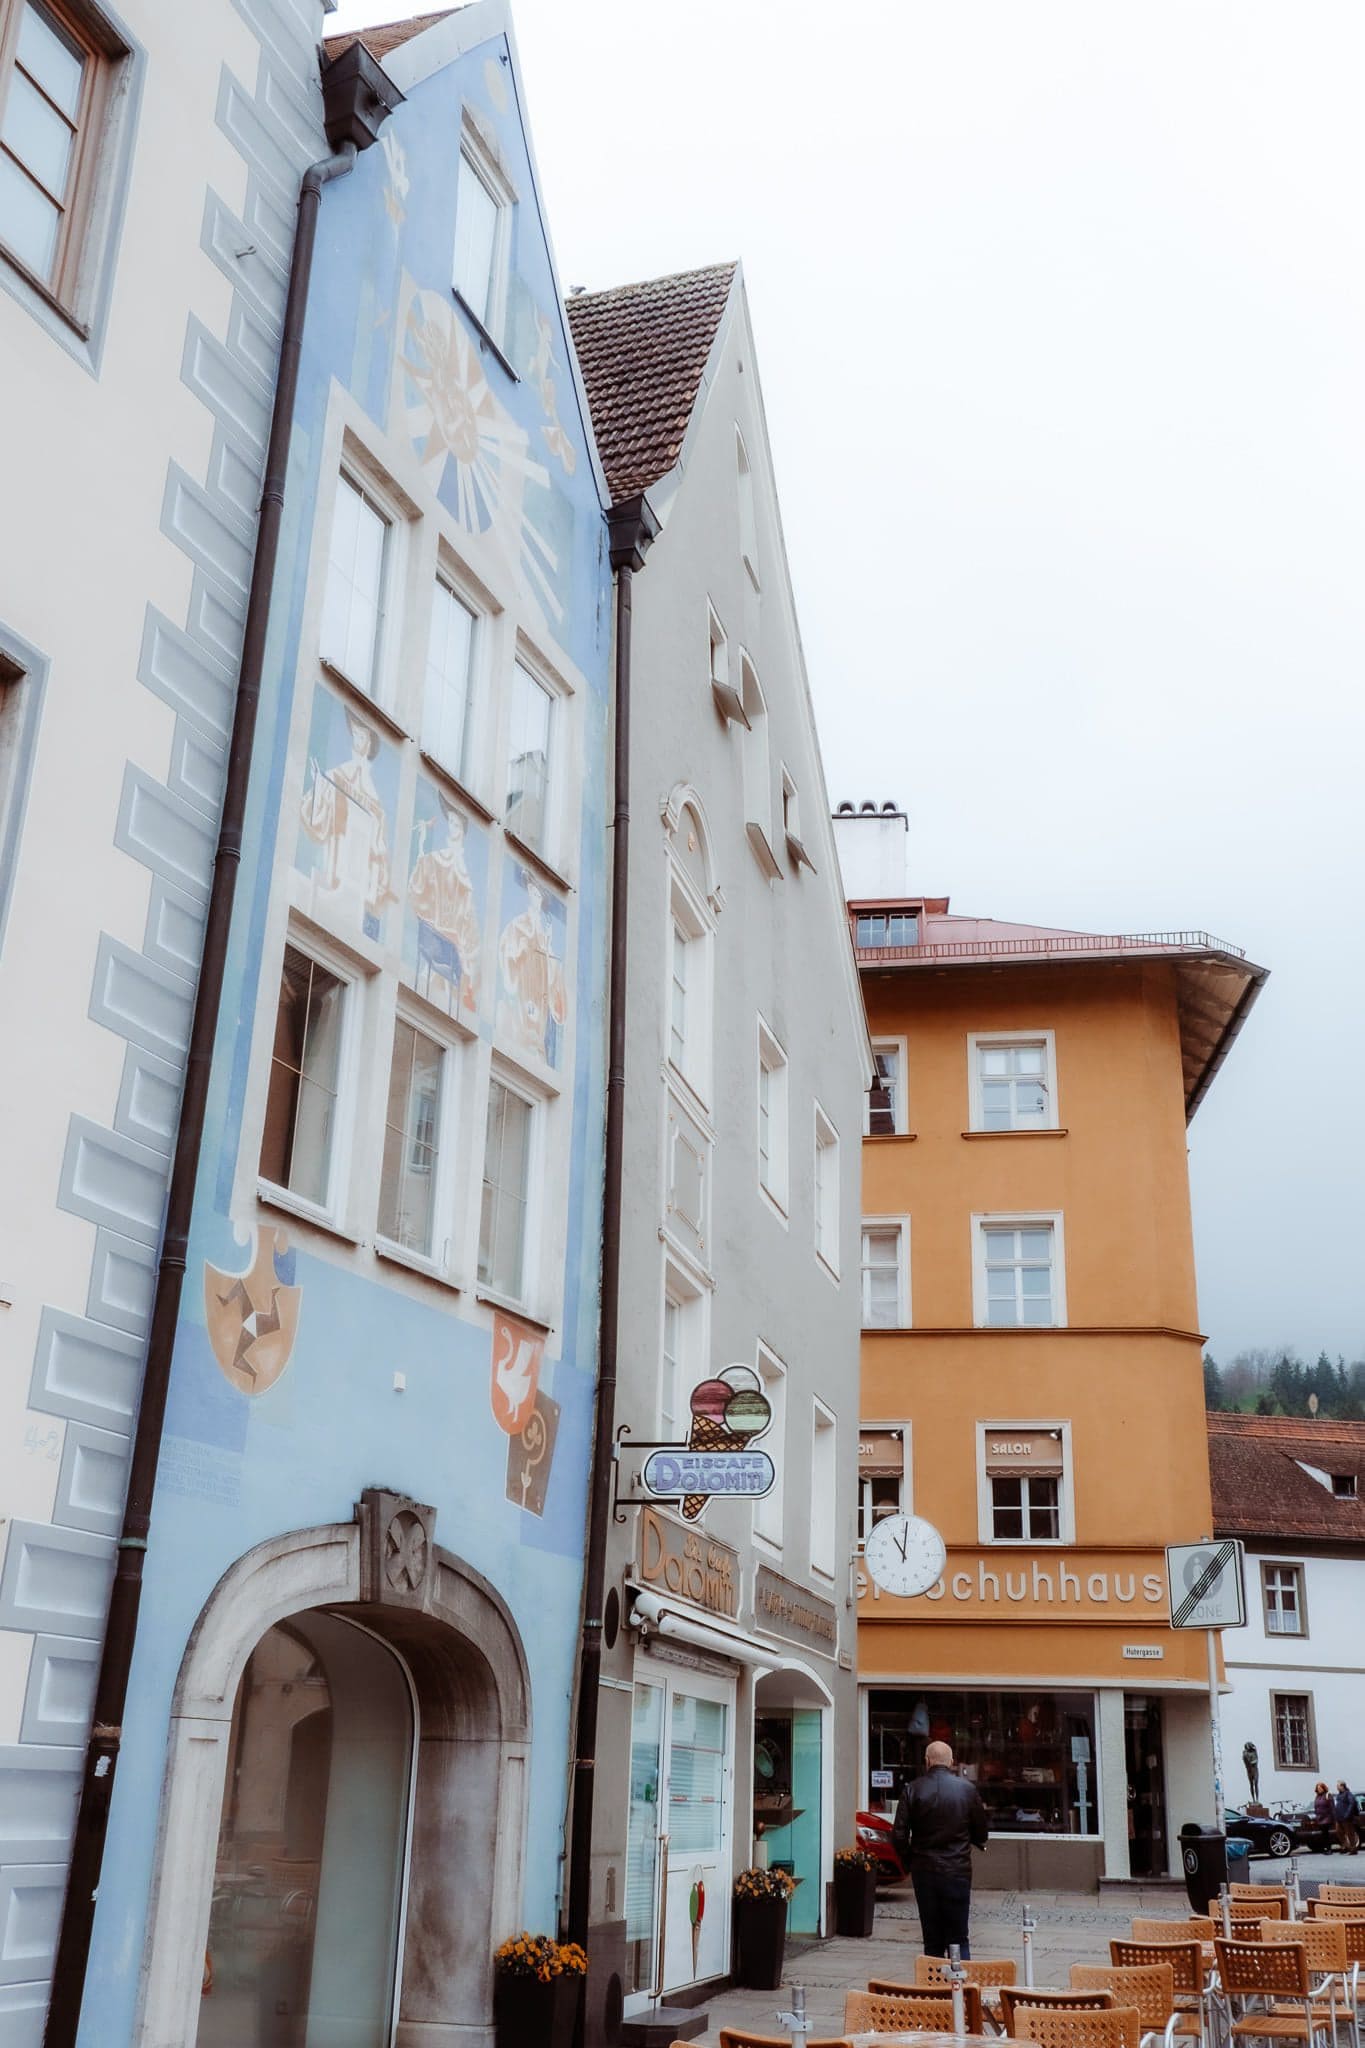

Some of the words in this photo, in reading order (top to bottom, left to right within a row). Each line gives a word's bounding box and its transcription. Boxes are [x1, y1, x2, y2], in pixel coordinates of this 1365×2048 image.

[991, 1443, 1032, 1455] SALON
[682, 1457, 764, 1470] EISCAFE
[655, 1457, 764, 1491] DOLOMITI
